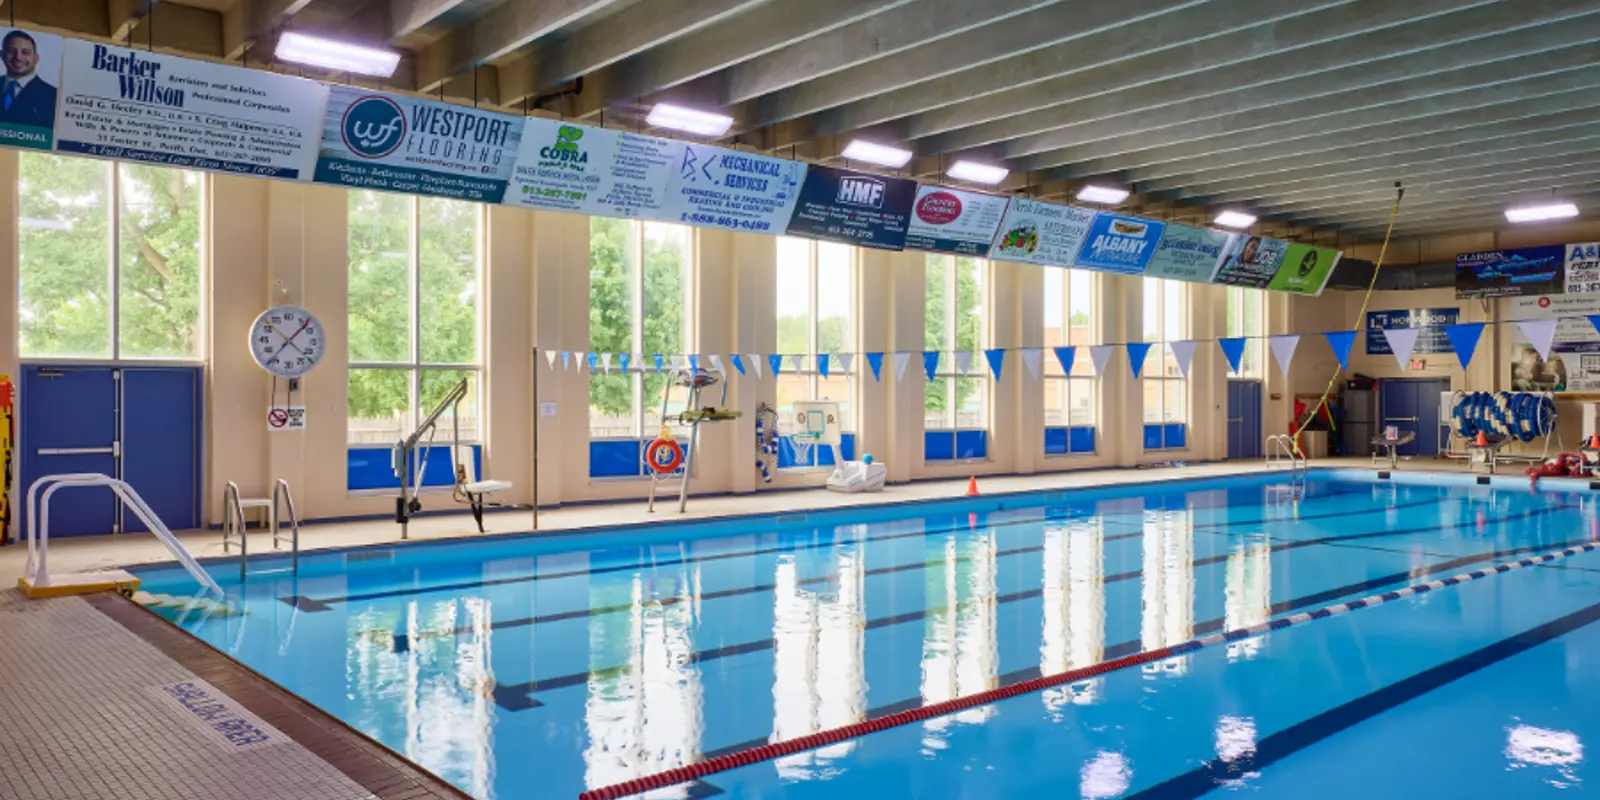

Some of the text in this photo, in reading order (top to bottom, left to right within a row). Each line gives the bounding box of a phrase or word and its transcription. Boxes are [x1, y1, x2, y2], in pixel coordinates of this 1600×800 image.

[91, 43, 161, 79] Barker
[119, 74, 184, 108] Willson
[65, 96, 93, 108] David
[64, 111, 85, 120] Real
[411, 104, 512, 147] WESTPORT
[125, 149, 165, 161] Service
[406, 133, 503, 165] FLOORING
[540, 146, 588, 163] COBRA
[719, 153, 781, 177] MECHANICAL
[724, 173, 769, 192] SERVICES
[840, 179, 883, 205] HMF
[681, 186, 731, 201] COMMERCIAL
[741, 195, 785, 208] INDUSTRIAL
[687, 195, 722, 207] HEATING
[725, 200, 741, 209] AND
[742, 203, 774, 214] COOLING
[1091, 234, 1149, 254] ALBANY
[259, 335, 269, 344] 45
[213, 719, 270, 746] WATER
